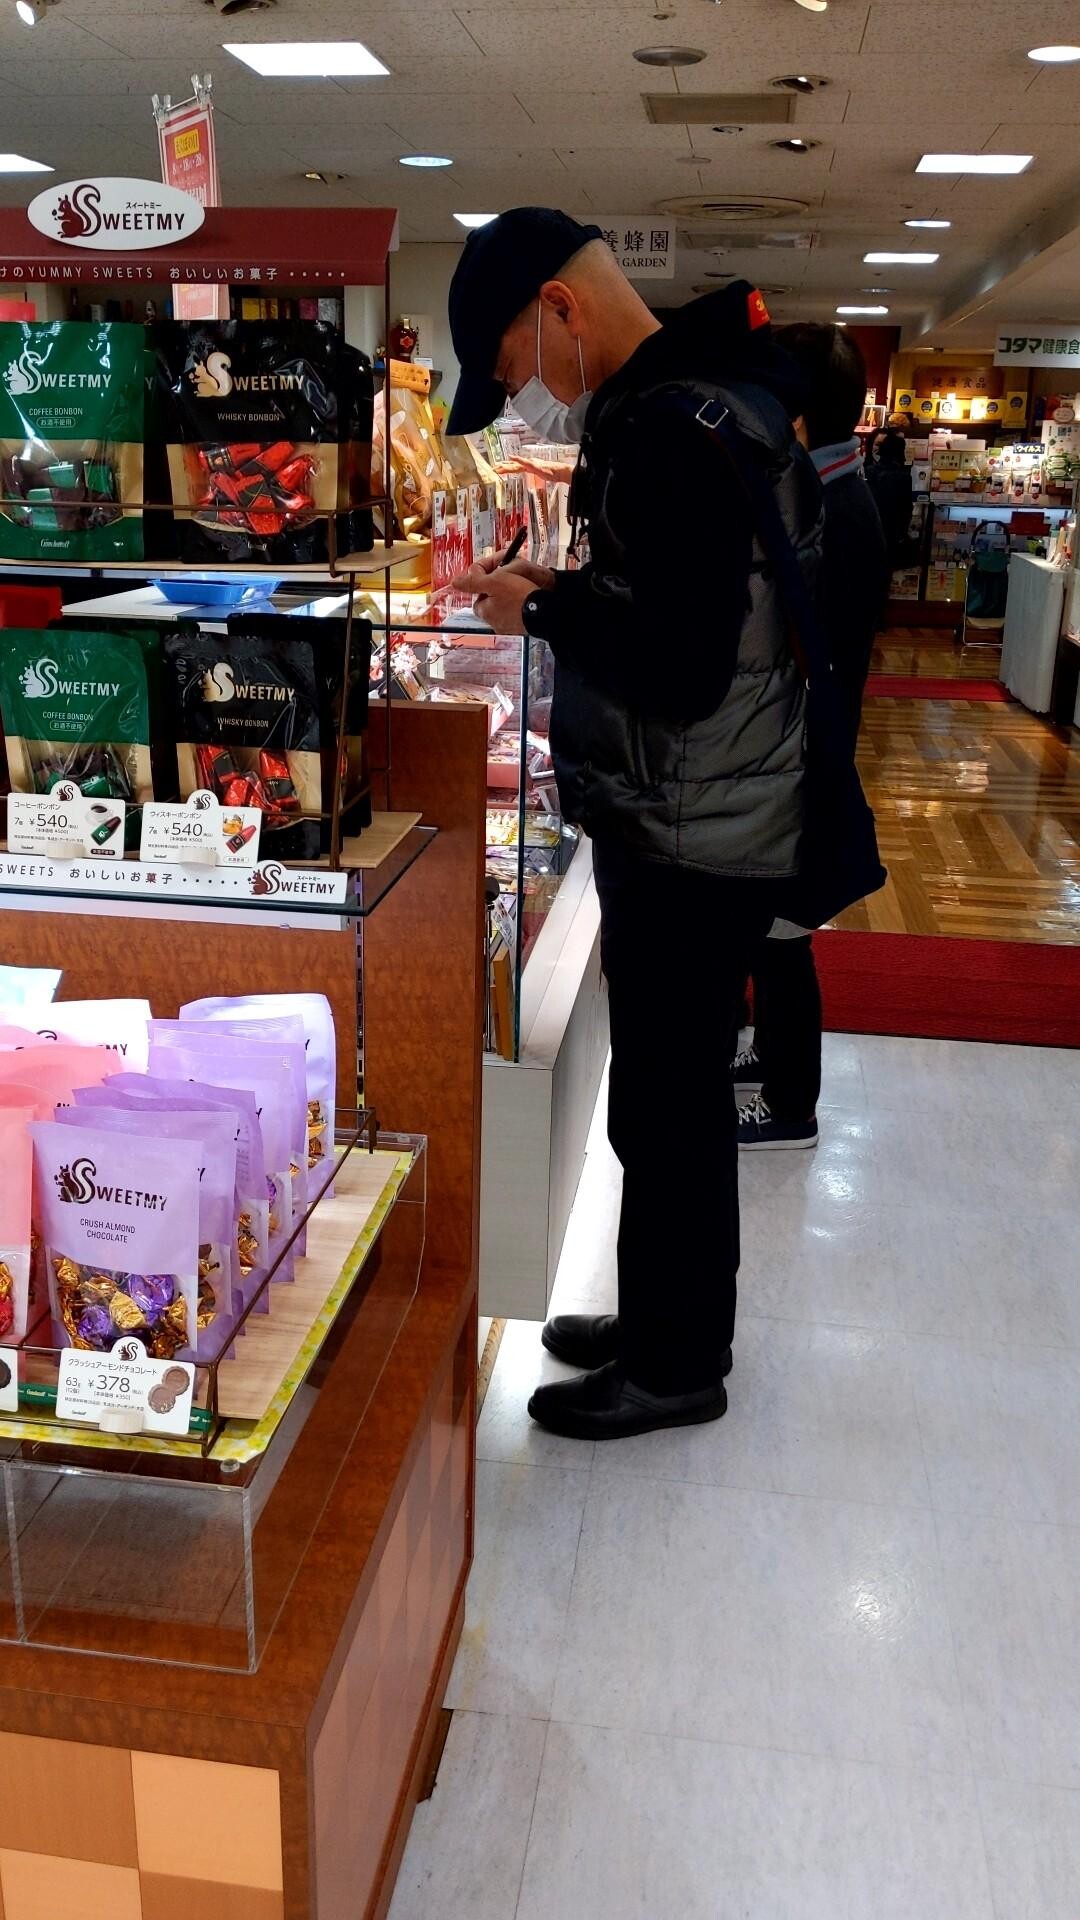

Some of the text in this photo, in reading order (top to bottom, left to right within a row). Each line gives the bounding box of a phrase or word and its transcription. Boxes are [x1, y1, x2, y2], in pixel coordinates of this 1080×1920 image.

[72, 184, 185, 237] SWEETMY
[622, 257, 667, 268] GARDEN
[93, 267, 153, 278] SWEETS
[170, 268, 278, 280] おいしいお菓子
[19, 351, 112, 394] SWEETMY
[207, 352, 305, 397] SWEETMY
[29, 407, 83, 416] COFFEE BONBON
[217, 413, 280, 422] WHISKY BONBON
[36, 658, 120, 698] SWEETMY
[213, 662, 296, 703] SWEETMY
[43, 711, 94, 721] COFFEE BONBON
[217, 717, 269, 728] WHISKY BONBON
[70, 868, 173, 885] おいしいお菓子
[262, 864, 336, 894] SWEETMY
[72, 1157, 168, 1212] SWEETMY
[80, 1218, 136, 1234] CRUSH ALMOND
[86, 1230, 128, 1244] CHOCOLATE
